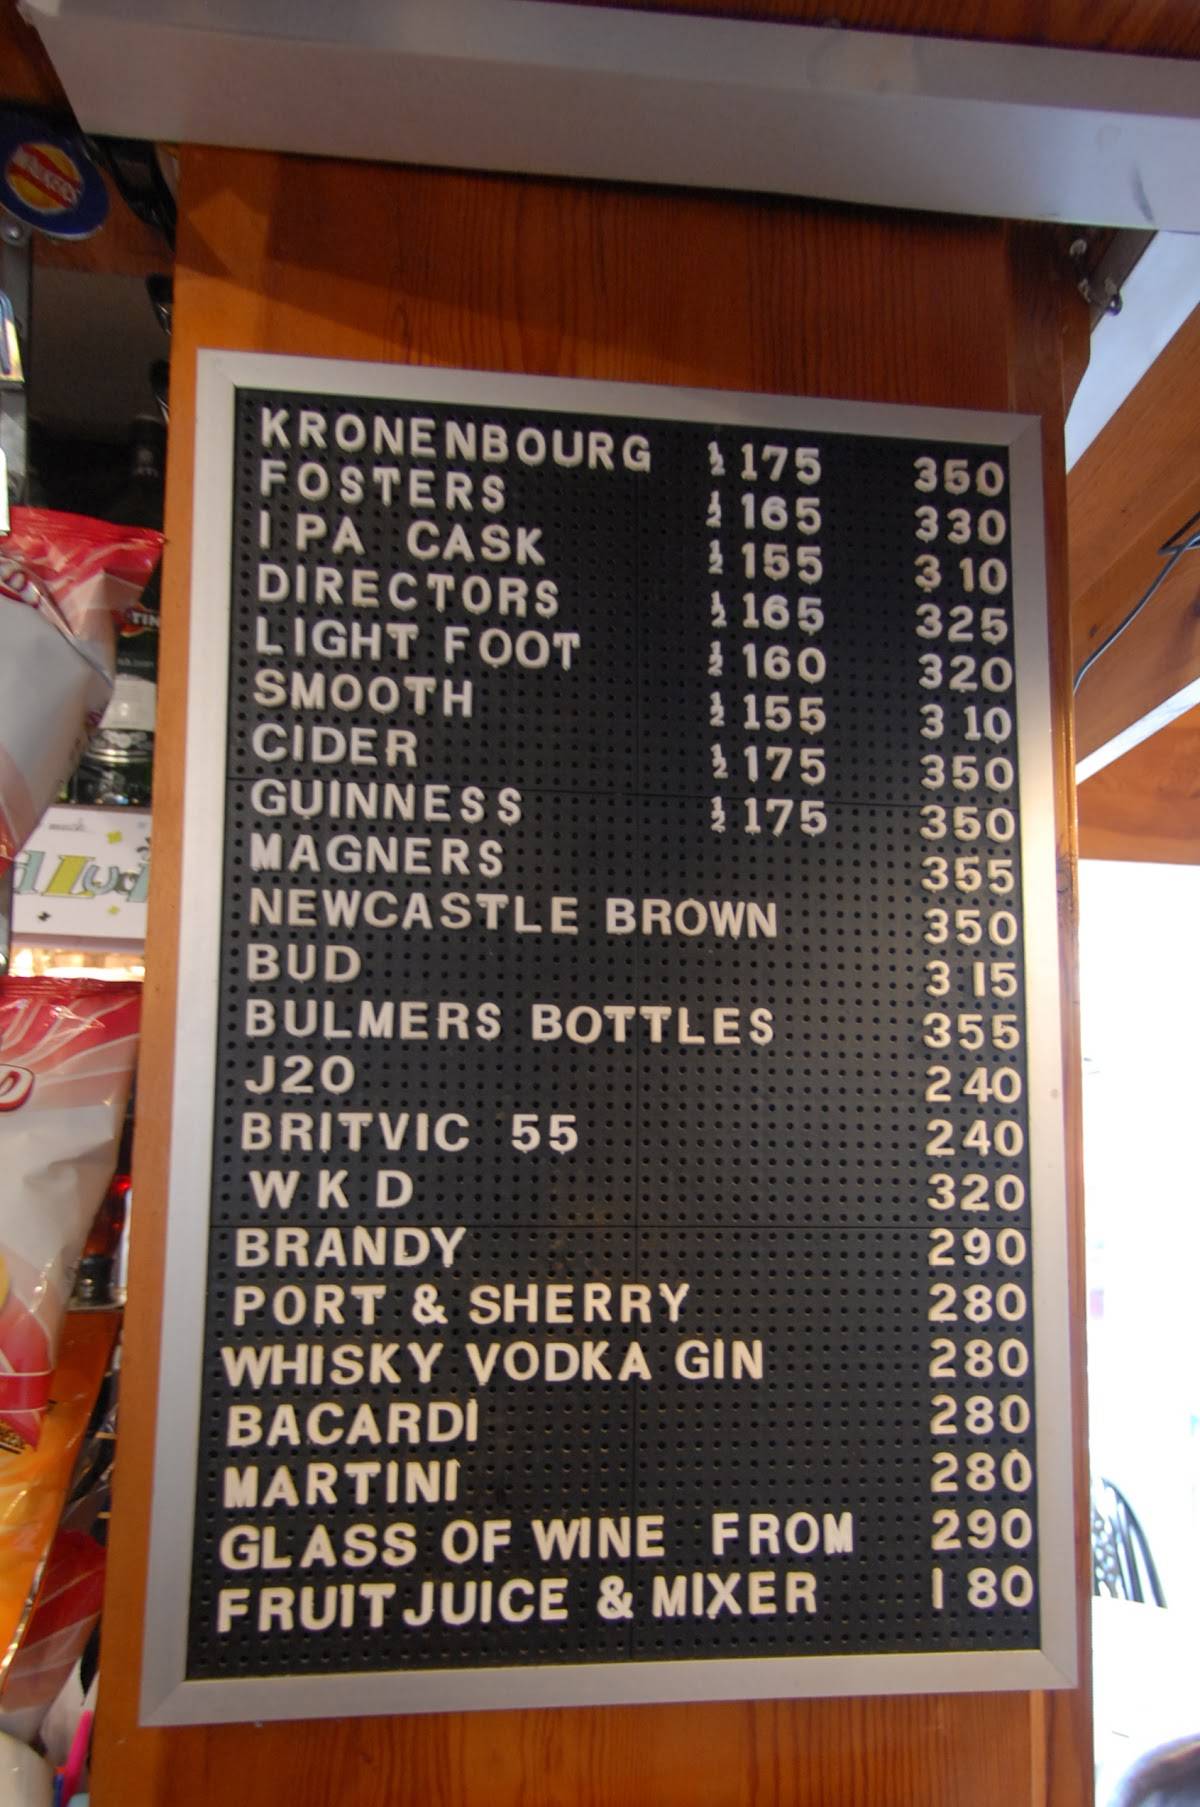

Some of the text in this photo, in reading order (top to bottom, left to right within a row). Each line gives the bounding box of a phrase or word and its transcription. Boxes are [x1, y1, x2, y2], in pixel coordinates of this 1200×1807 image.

[261, 407, 651, 471] KRONENBOURG
[742, 443, 821, 484] 175
[914, 457, 1004, 495] 350
[260, 458, 505, 512] FOSTERS
[741, 493, 822, 535] 165
[915, 505, 1006, 544] 330
[407, 520, 545, 564] CASK
[742, 542, 823, 584] 155
[258, 563, 558, 618] DIRECTORS
[743, 592, 825, 635] 165
[916, 603, 1008, 645] 325
[255, 615, 419, 660] LIGHT
[444, 625, 580, 671] FOOT
[742, 643, 827, 684] 160
[918, 653, 1011, 693] 320
[252, 668, 473, 717] SMOOTH
[743, 693, 827, 735] 155
[251, 722, 417, 766] CIDER
[743, 745, 826, 786] 175
[920, 753, 1014, 793] 350
[250, 778, 522, 826] GUINNESS
[744, 797, 828, 837] 175
[920, 804, 1016, 844] 350
[249, 831, 1015, 894] MAGNERS 355
[249, 887, 1017, 945] NEWCASTLE BROWN 350
[246, 942, 361, 983] BUD
[245, 998, 1021, 1051] BULMERS BOTTLES 355
[925, 1065, 1022, 1103] 240
[240, 1111, 1024, 1159] BRITVIC 55 240
[927, 1173, 1026, 1214] 320
[235, 1225, 1027, 1269] BRANDY 290
[233, 1282, 1028, 1328] PORT & SHERRY 280
[220, 1337, 1030, 1390] WHISKY VODKA GIN 280
[226, 1394, 1031, 1448] BACARDI 280
[223, 1448, 1033, 1509] MARTINI 280
[219, 1508, 1033, 1571] GLASS OF WINE FROM 290
[217, 1584, 396, 1633] FRUIT
[403, 1578, 568, 1627] JUICE
[597, 1575, 634, 1620] &
[652, 1571, 817, 1620] MIXER
